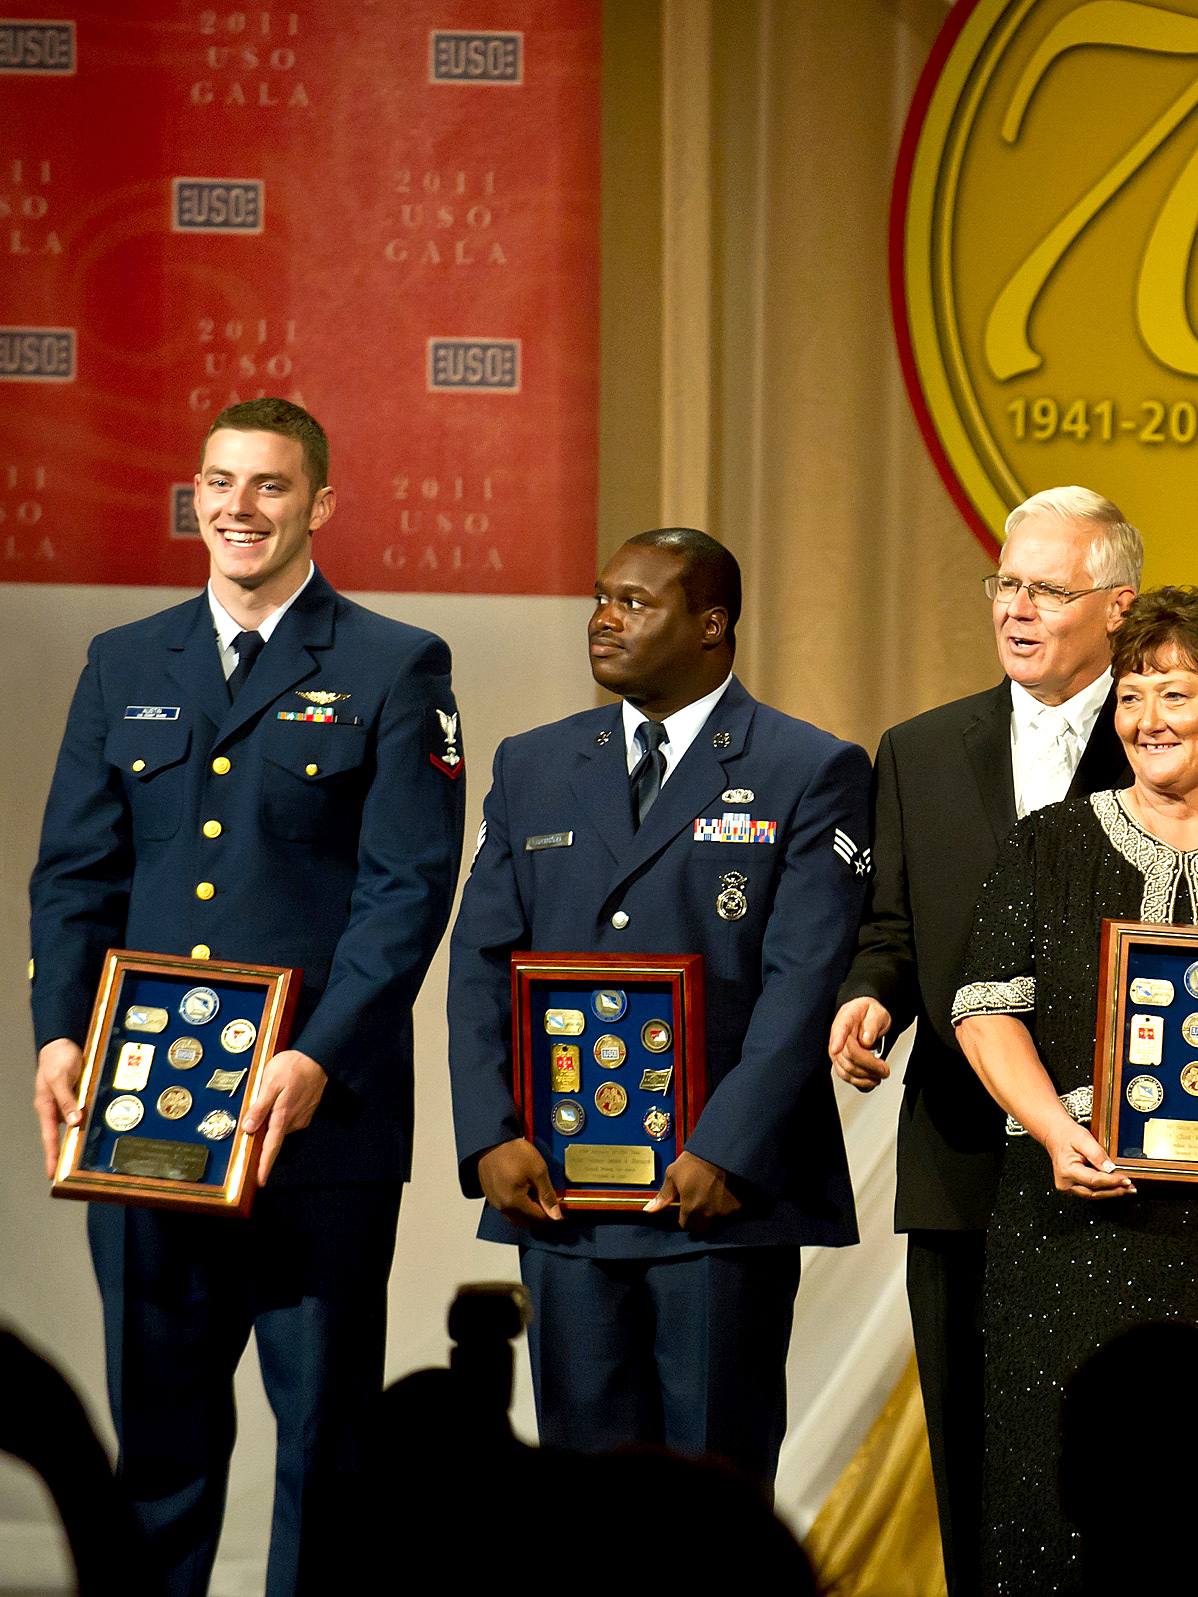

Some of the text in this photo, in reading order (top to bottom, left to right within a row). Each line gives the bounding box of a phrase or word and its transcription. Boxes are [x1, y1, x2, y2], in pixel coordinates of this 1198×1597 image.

[200, 11, 299, 35] 2011
[206, 47, 296, 71] USO
[449, 40, 505, 75] USO
[190, 82, 309, 106] GALA
[396, 169, 495, 195] 2011
[192, 187, 247, 223] USO
[401, 204, 492, 229] USO
[384, 237, 507, 265] GALA
[199, 318, 297, 343] 2011
[205, 353, 293, 379] USO
[447, 348, 502, 382] USO
[393, 474, 493, 500] 2011
[401, 510, 490, 535] USO
[383, 545, 503, 571] GALA
